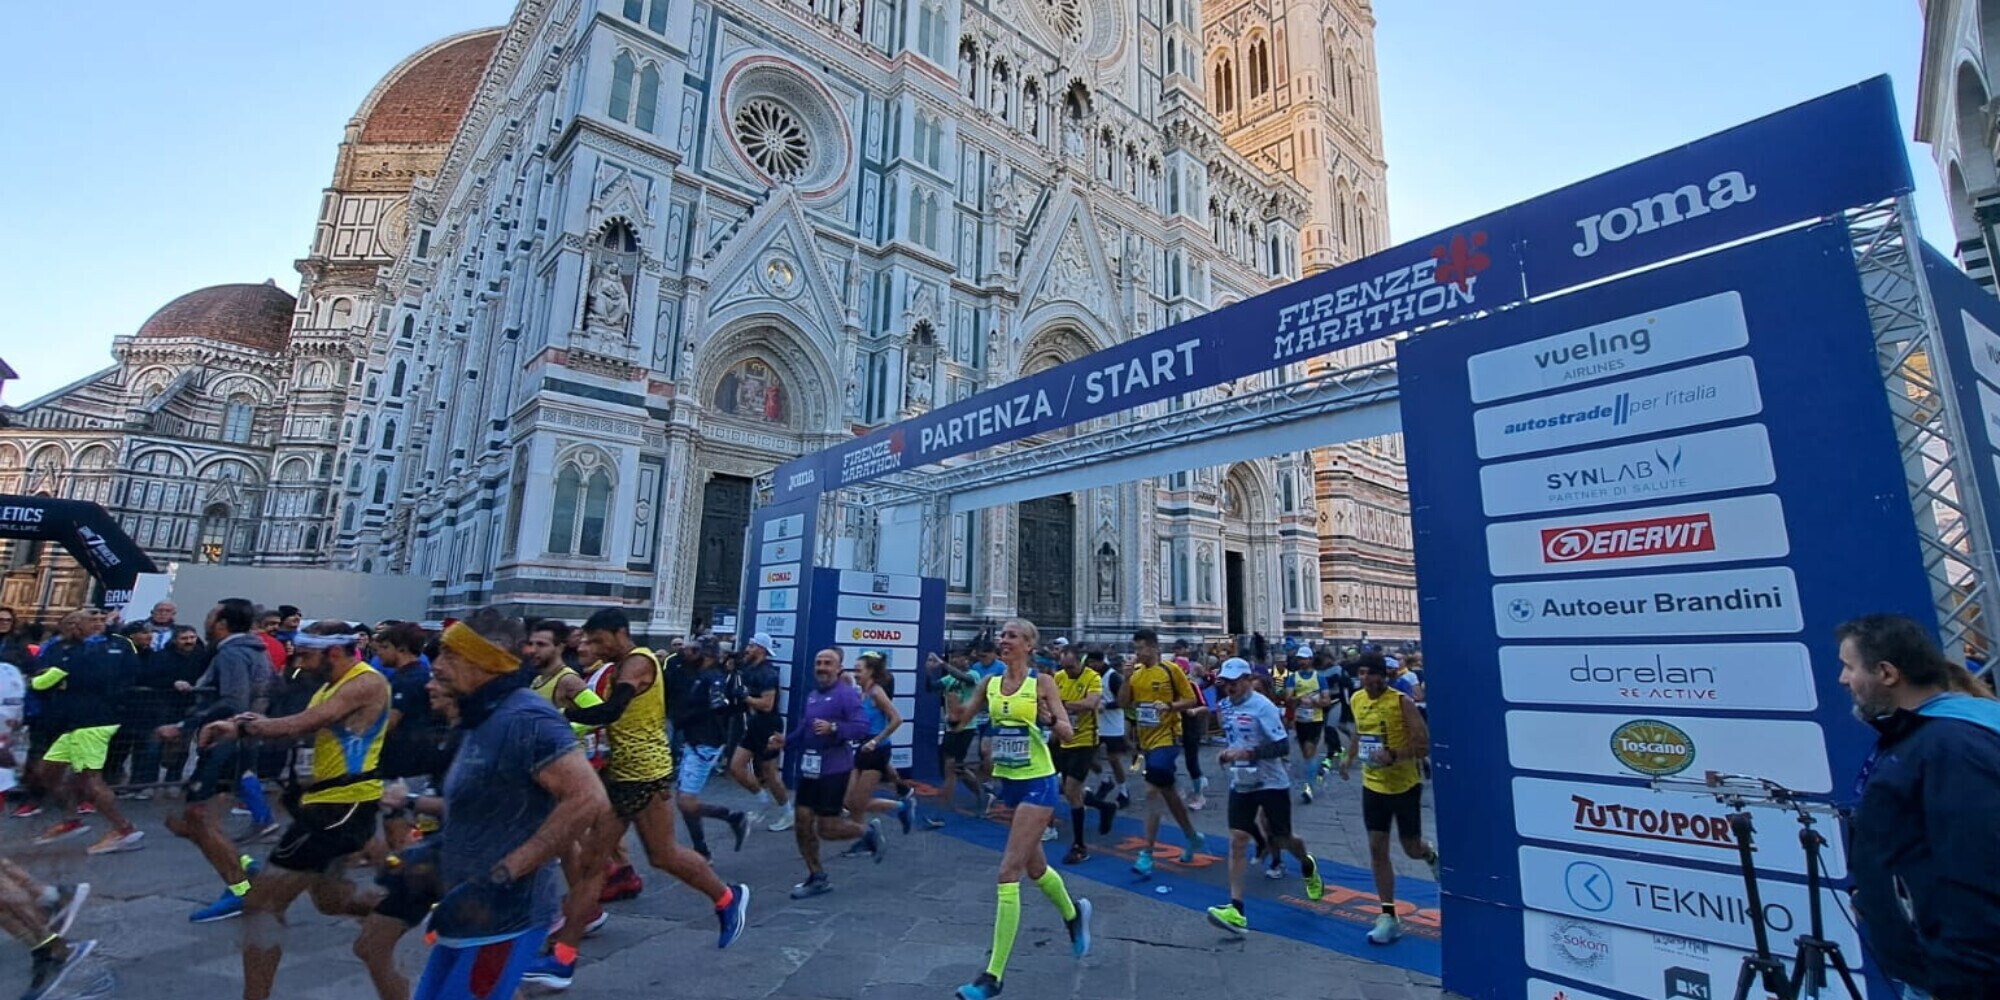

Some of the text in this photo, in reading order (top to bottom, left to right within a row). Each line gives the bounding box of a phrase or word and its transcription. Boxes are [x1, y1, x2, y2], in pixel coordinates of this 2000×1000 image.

[1573, 171, 1757, 258] Joma
[1277, 258, 1439, 332] FIRENZE
[1274, 277, 1477, 360] MARATHON
[1534, 327, 1651, 370] vueling
[1563, 359, 1626, 381] AIRLINES
[920, 339, 1201, 454] PARTENZA / START
[1504, 385, 1717, 435] autostrade per l'italia
[841, 452, 902, 483] MARATHON
[843, 440, 892, 468] FIRENZE
[1546, 461, 1653, 490] SYNLAB
[1549, 478, 1688, 502] PARTNER DI SALUTE
[0, 506, 44, 522] ETICS
[1592, 521, 1709, 555] ENERVIT
[1541, 586, 1783, 618] Autoeur Brandini
[862, 629, 902, 641] CONAD
[1569, 654, 1715, 684] dorelan
[1619, 737, 1686, 755] Toscano
[1571, 794, 1743, 843] TUTTOSPOR
